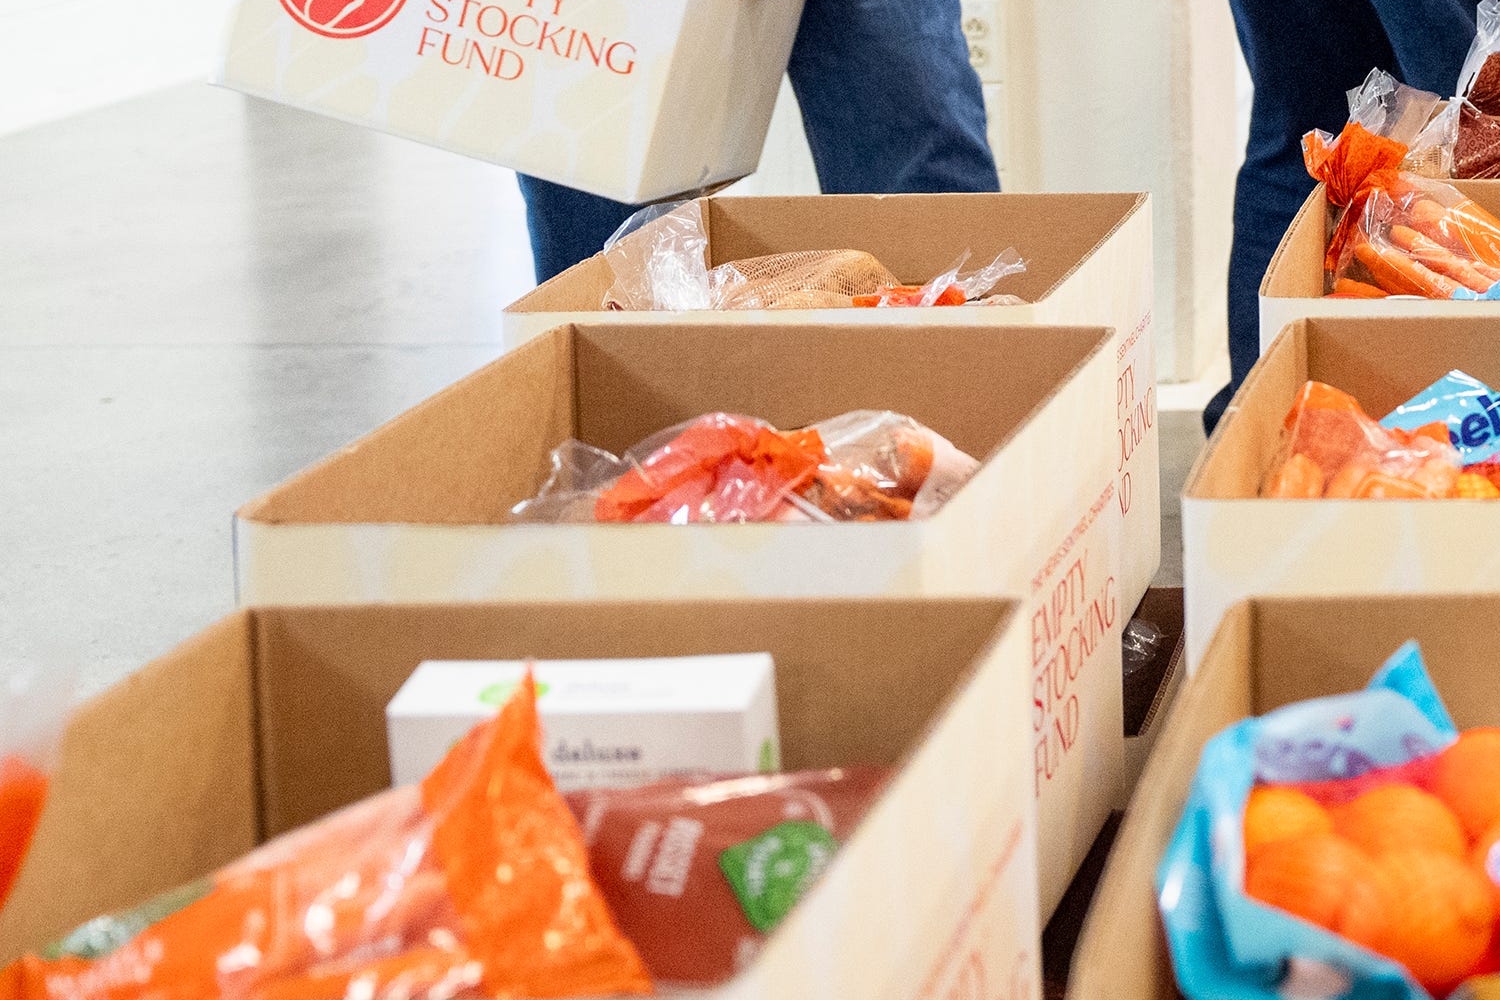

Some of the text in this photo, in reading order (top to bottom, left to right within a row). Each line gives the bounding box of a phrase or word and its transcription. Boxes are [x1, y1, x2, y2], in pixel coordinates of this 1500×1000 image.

[417, 27, 524, 81] FUND
[1117, 358, 1135, 420] PTY
[1032, 548, 1089, 669] EMPTY
[1032, 576, 1116, 732] STOCKING
[1034, 694, 1080, 798] FUND
